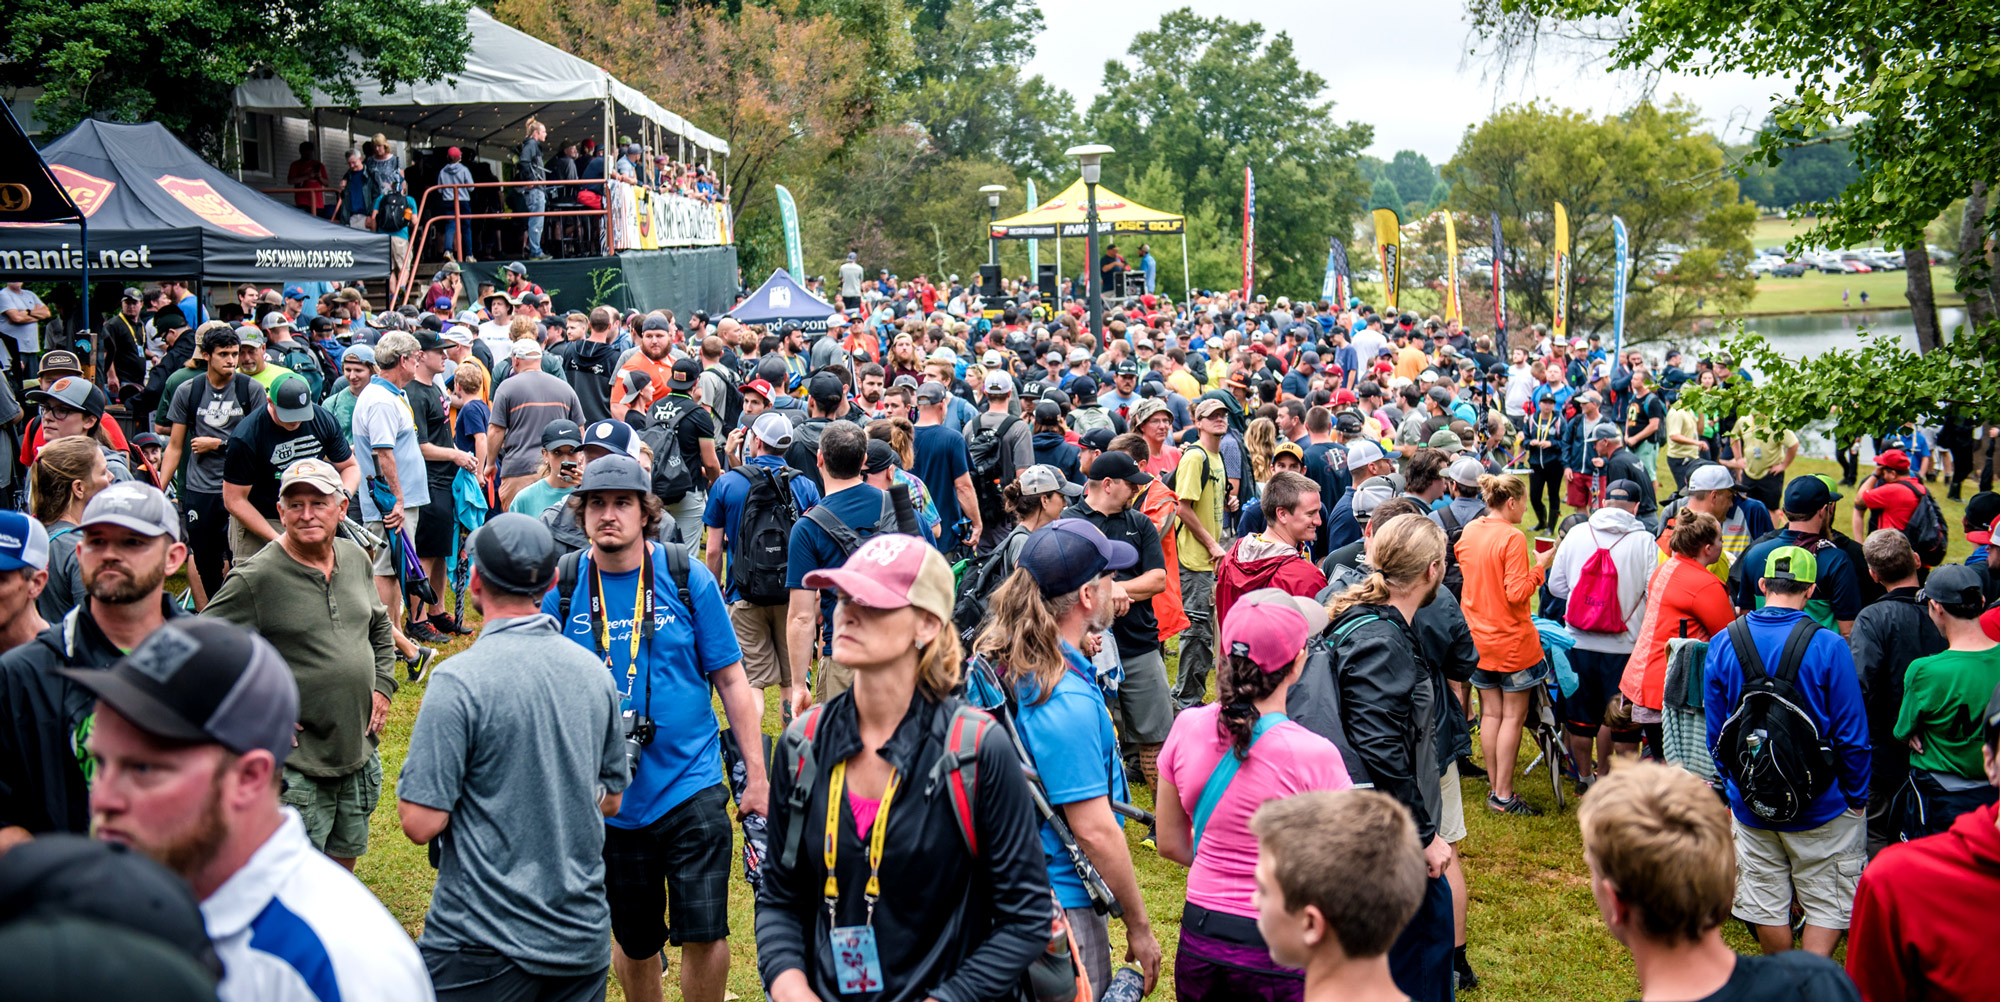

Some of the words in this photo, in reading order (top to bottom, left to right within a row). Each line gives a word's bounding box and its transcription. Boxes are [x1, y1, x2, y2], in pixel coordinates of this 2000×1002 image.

[1063, 222, 1111, 236] INNVA
[1115, 220, 1146, 232] DISC
[1148, 220, 1182, 232] GOLF
[255, 248, 307, 268] DISCMANIA
[307, 249, 330, 268] GOLF
[330, 250, 354, 268] DISCS
[1387, 244, 1397, 294] INNOVA
[1559, 254, 1567, 319] INNOVA
